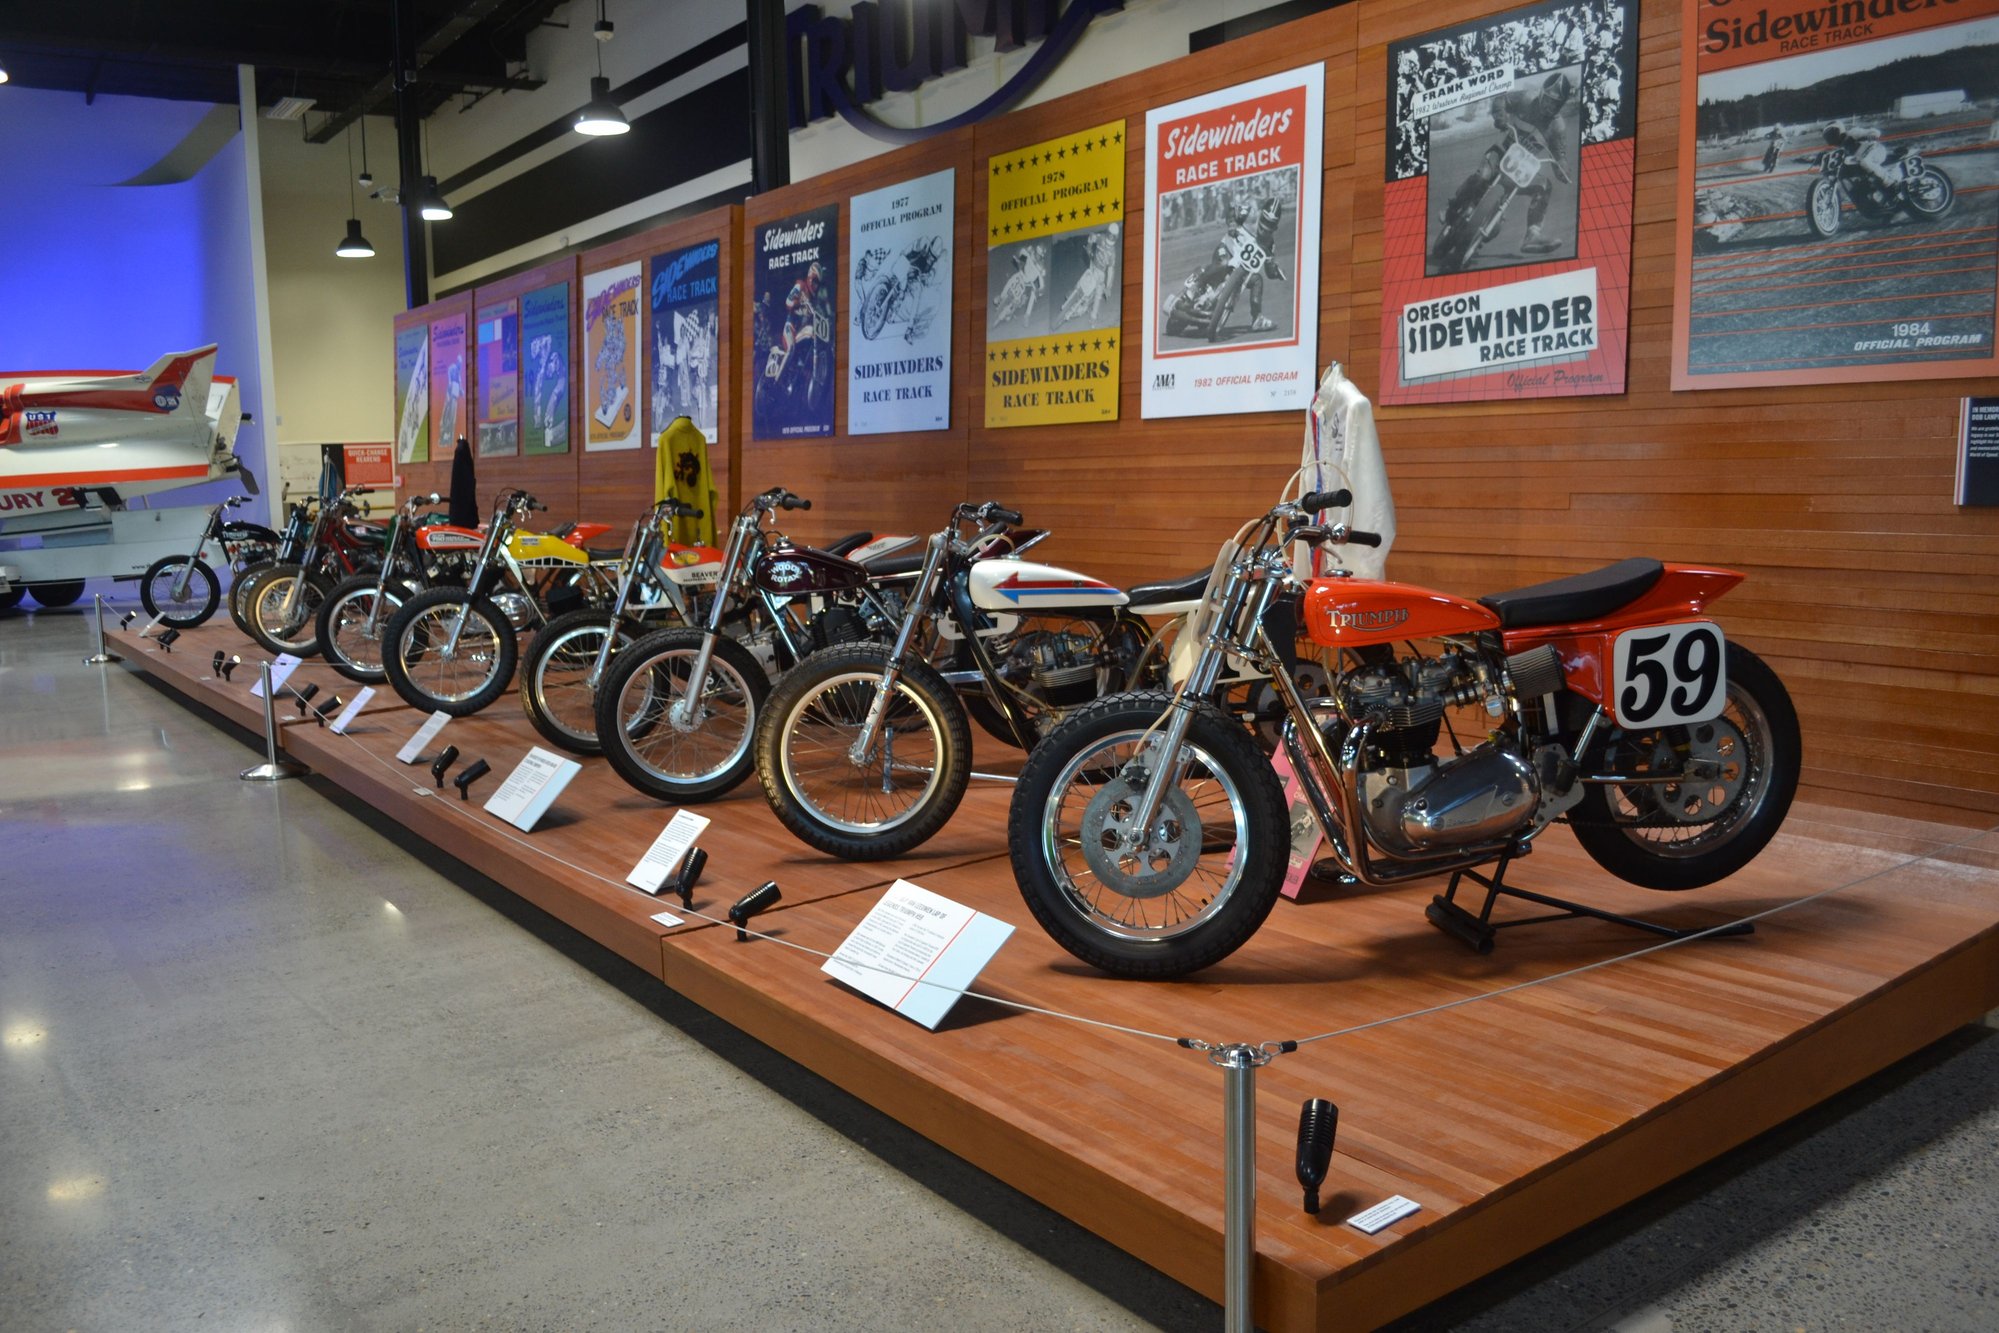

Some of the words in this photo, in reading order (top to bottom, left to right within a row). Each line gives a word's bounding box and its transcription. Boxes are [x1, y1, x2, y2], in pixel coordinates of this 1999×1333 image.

[1780, 33, 1818, 54] RACE
[1823, 22, 1873, 46] TRACK
[1422, 82, 1463, 102] FRANK
[1468, 69, 1504, 87] WORD
[1460, 86, 1486, 102] Regional
[1488, 80, 1512, 94] Champ
[1164, 107, 1293, 159] Sidewinders
[1041, 170, 1065, 185] 1978
[1176, 161, 1218, 185] RACE
[1224, 146, 1281, 173] TRACK
[891, 197, 910, 210] 1977
[1001, 192, 1048, 212] OFFICIAL
[1053, 177, 1109, 201] PROGRAM
[861, 216, 897, 233] OFFICIAL
[900, 204, 943, 223] PROGRAM
[763, 220, 825, 252] Sidewinders
[768, 254, 789, 270] RACE
[791, 247, 819, 264] TRACK
[1240, 243, 1264, 269] 85
[690, 276, 717, 298] TRACK
[619, 299, 639, 317] TRACK
[1407, 295, 1481, 323] OREGON
[1408, 295, 1592, 354] SIDEWINDER
[1892, 322, 1930, 337] 1984
[1480, 338, 1526, 363] RACE
[1531, 326, 1593, 355] TRACK
[1854, 338, 1910, 352] OFFICIAL
[1915, 333, 1982, 348] PROGRAM
[854, 355, 943, 380] SIDEWINDERS
[992, 360, 1110, 388] SIDEWINDERS
[1194, 378, 1212, 388] 1982
[1216, 375, 1251, 386] OFFICIAL
[1255, 370, 1298, 383] PROGRAM
[1506, 371, 1548, 392] Official
[1553, 367, 1603, 387] Program
[863, 388, 891, 403] RACE
[895, 385, 932, 400] TRACK
[1003, 391, 1039, 409] RACE
[1045, 388, 1095, 406] TRACK
[770, 574, 799, 582] ROTAX
[1325, 607, 1409, 630] TRIUMPH
[1620, 627, 1721, 723] 59
